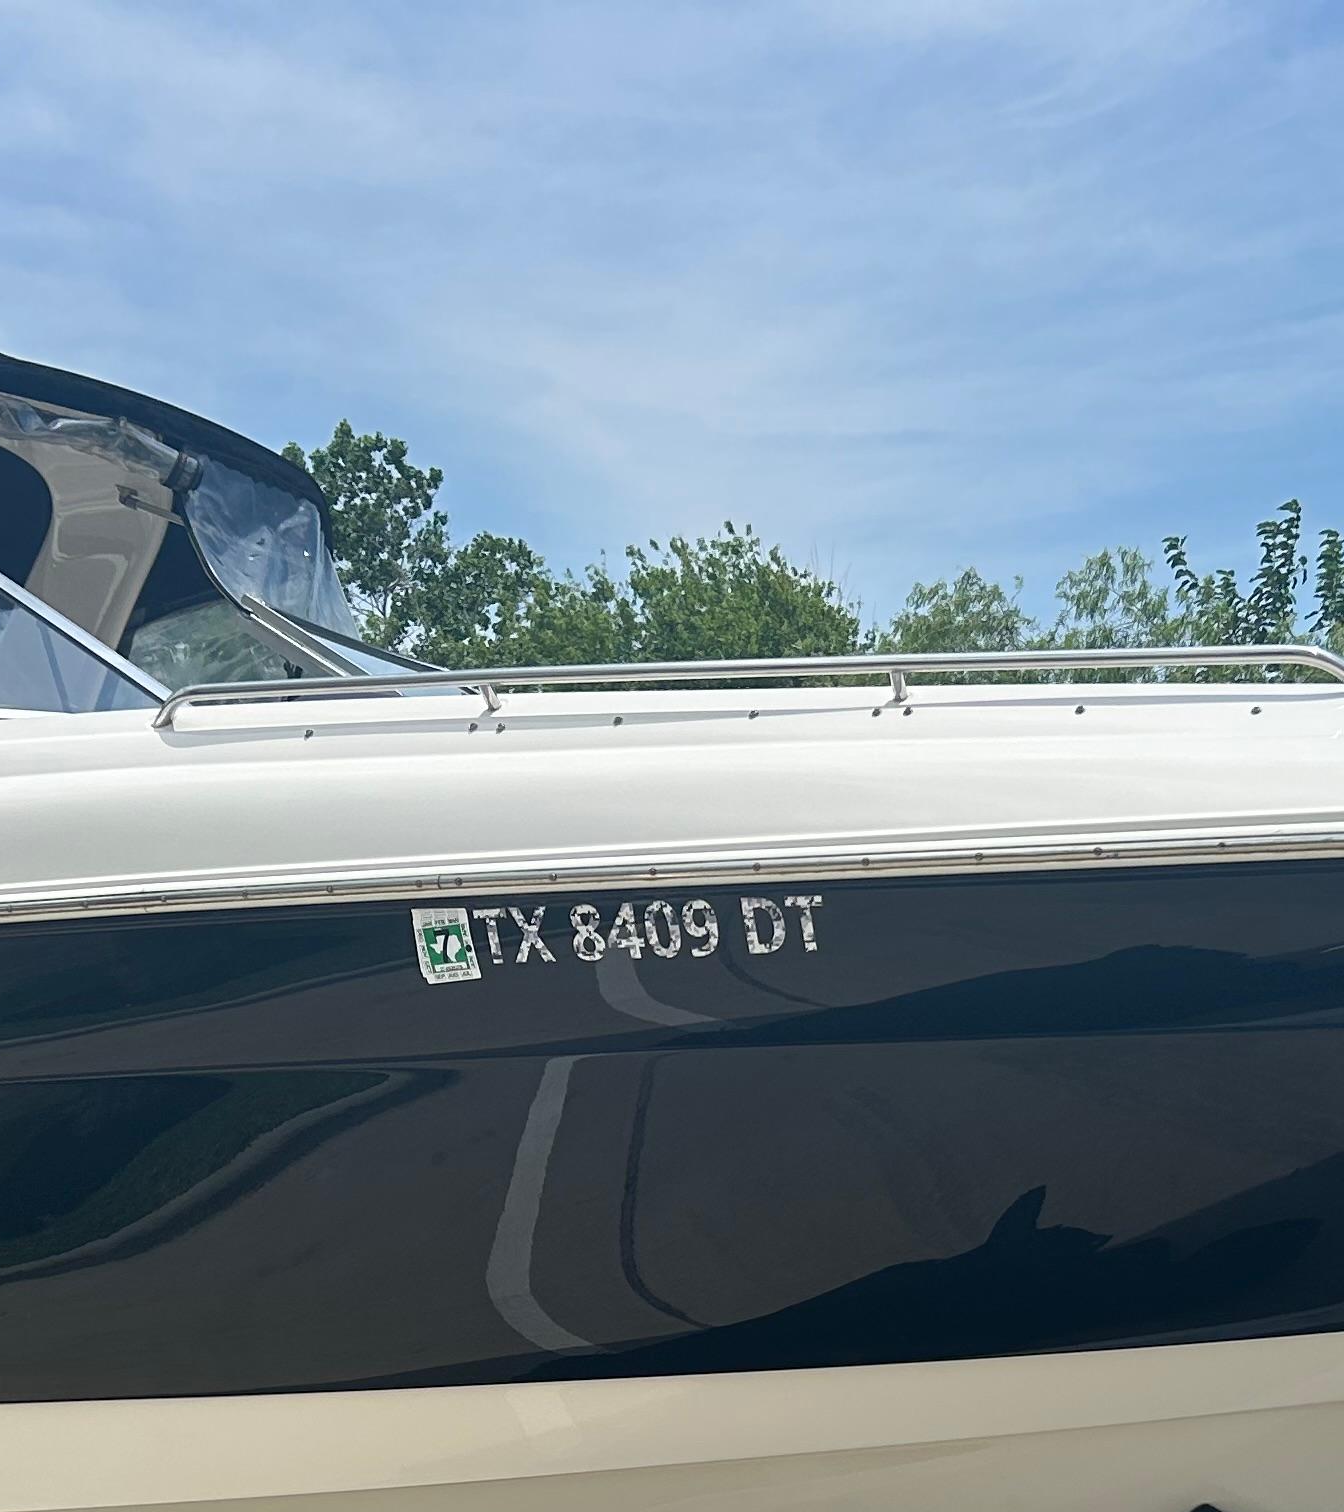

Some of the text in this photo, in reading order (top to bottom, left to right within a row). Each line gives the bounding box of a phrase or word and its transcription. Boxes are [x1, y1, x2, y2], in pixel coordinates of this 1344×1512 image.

[473, 906, 557, 964] TX
[569, 899, 720, 962] 8409
[740, 895, 823, 954] DT
